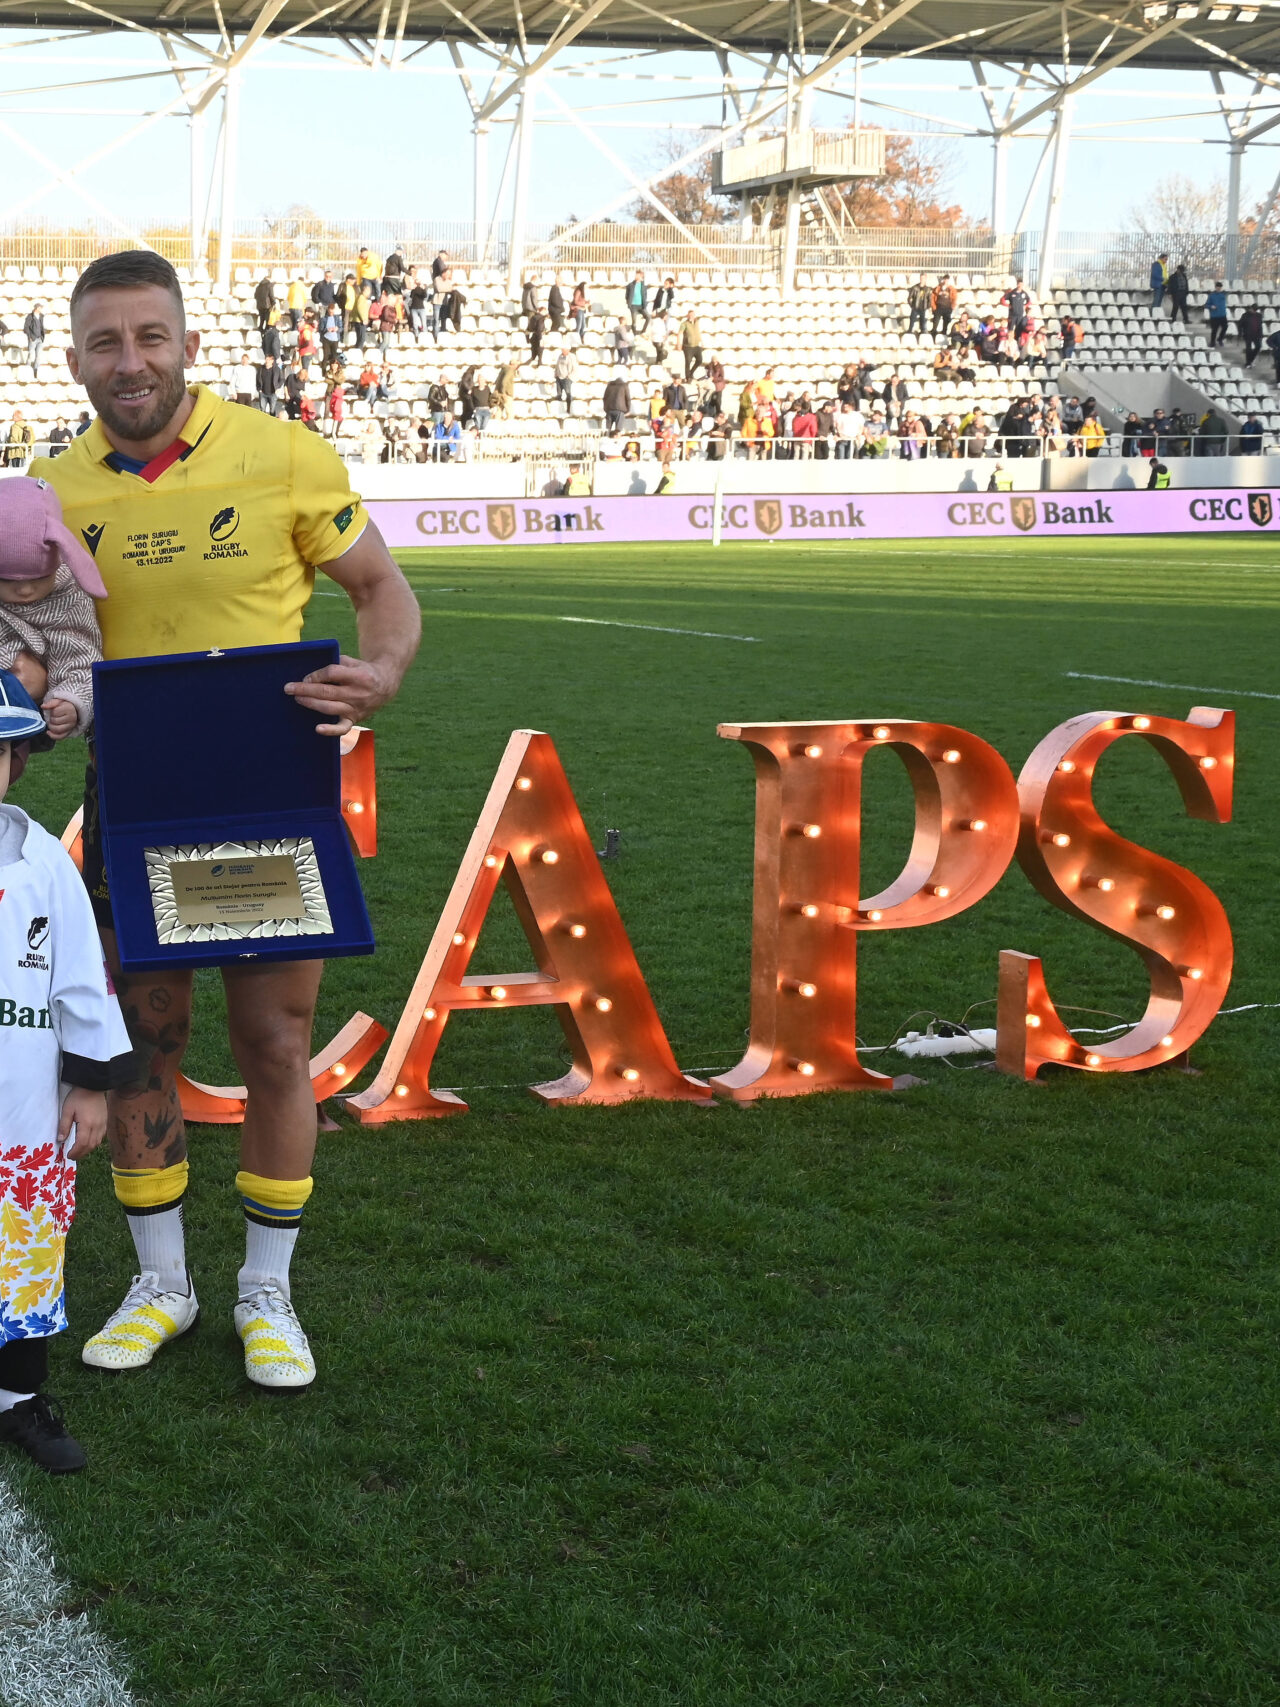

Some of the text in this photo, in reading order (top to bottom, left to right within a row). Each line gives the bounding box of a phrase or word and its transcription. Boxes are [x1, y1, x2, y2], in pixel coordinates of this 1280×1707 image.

[789, 502, 866, 528] Bank
[947, 499, 1114, 526] CEC Bank
[1189, 498, 1243, 521] CEC
[416, 506, 604, 535] CEC Bank
[127, 530, 179, 542] FLORIN SURUGIU
[134, 539, 171, 549] 100 CAP'S
[211, 542, 241, 551] RUGBY
[122, 550, 149, 560] ROMANIA
[158, 545, 186, 555] URUGUAY
[136, 556, 173, 567] 13.11.2022
